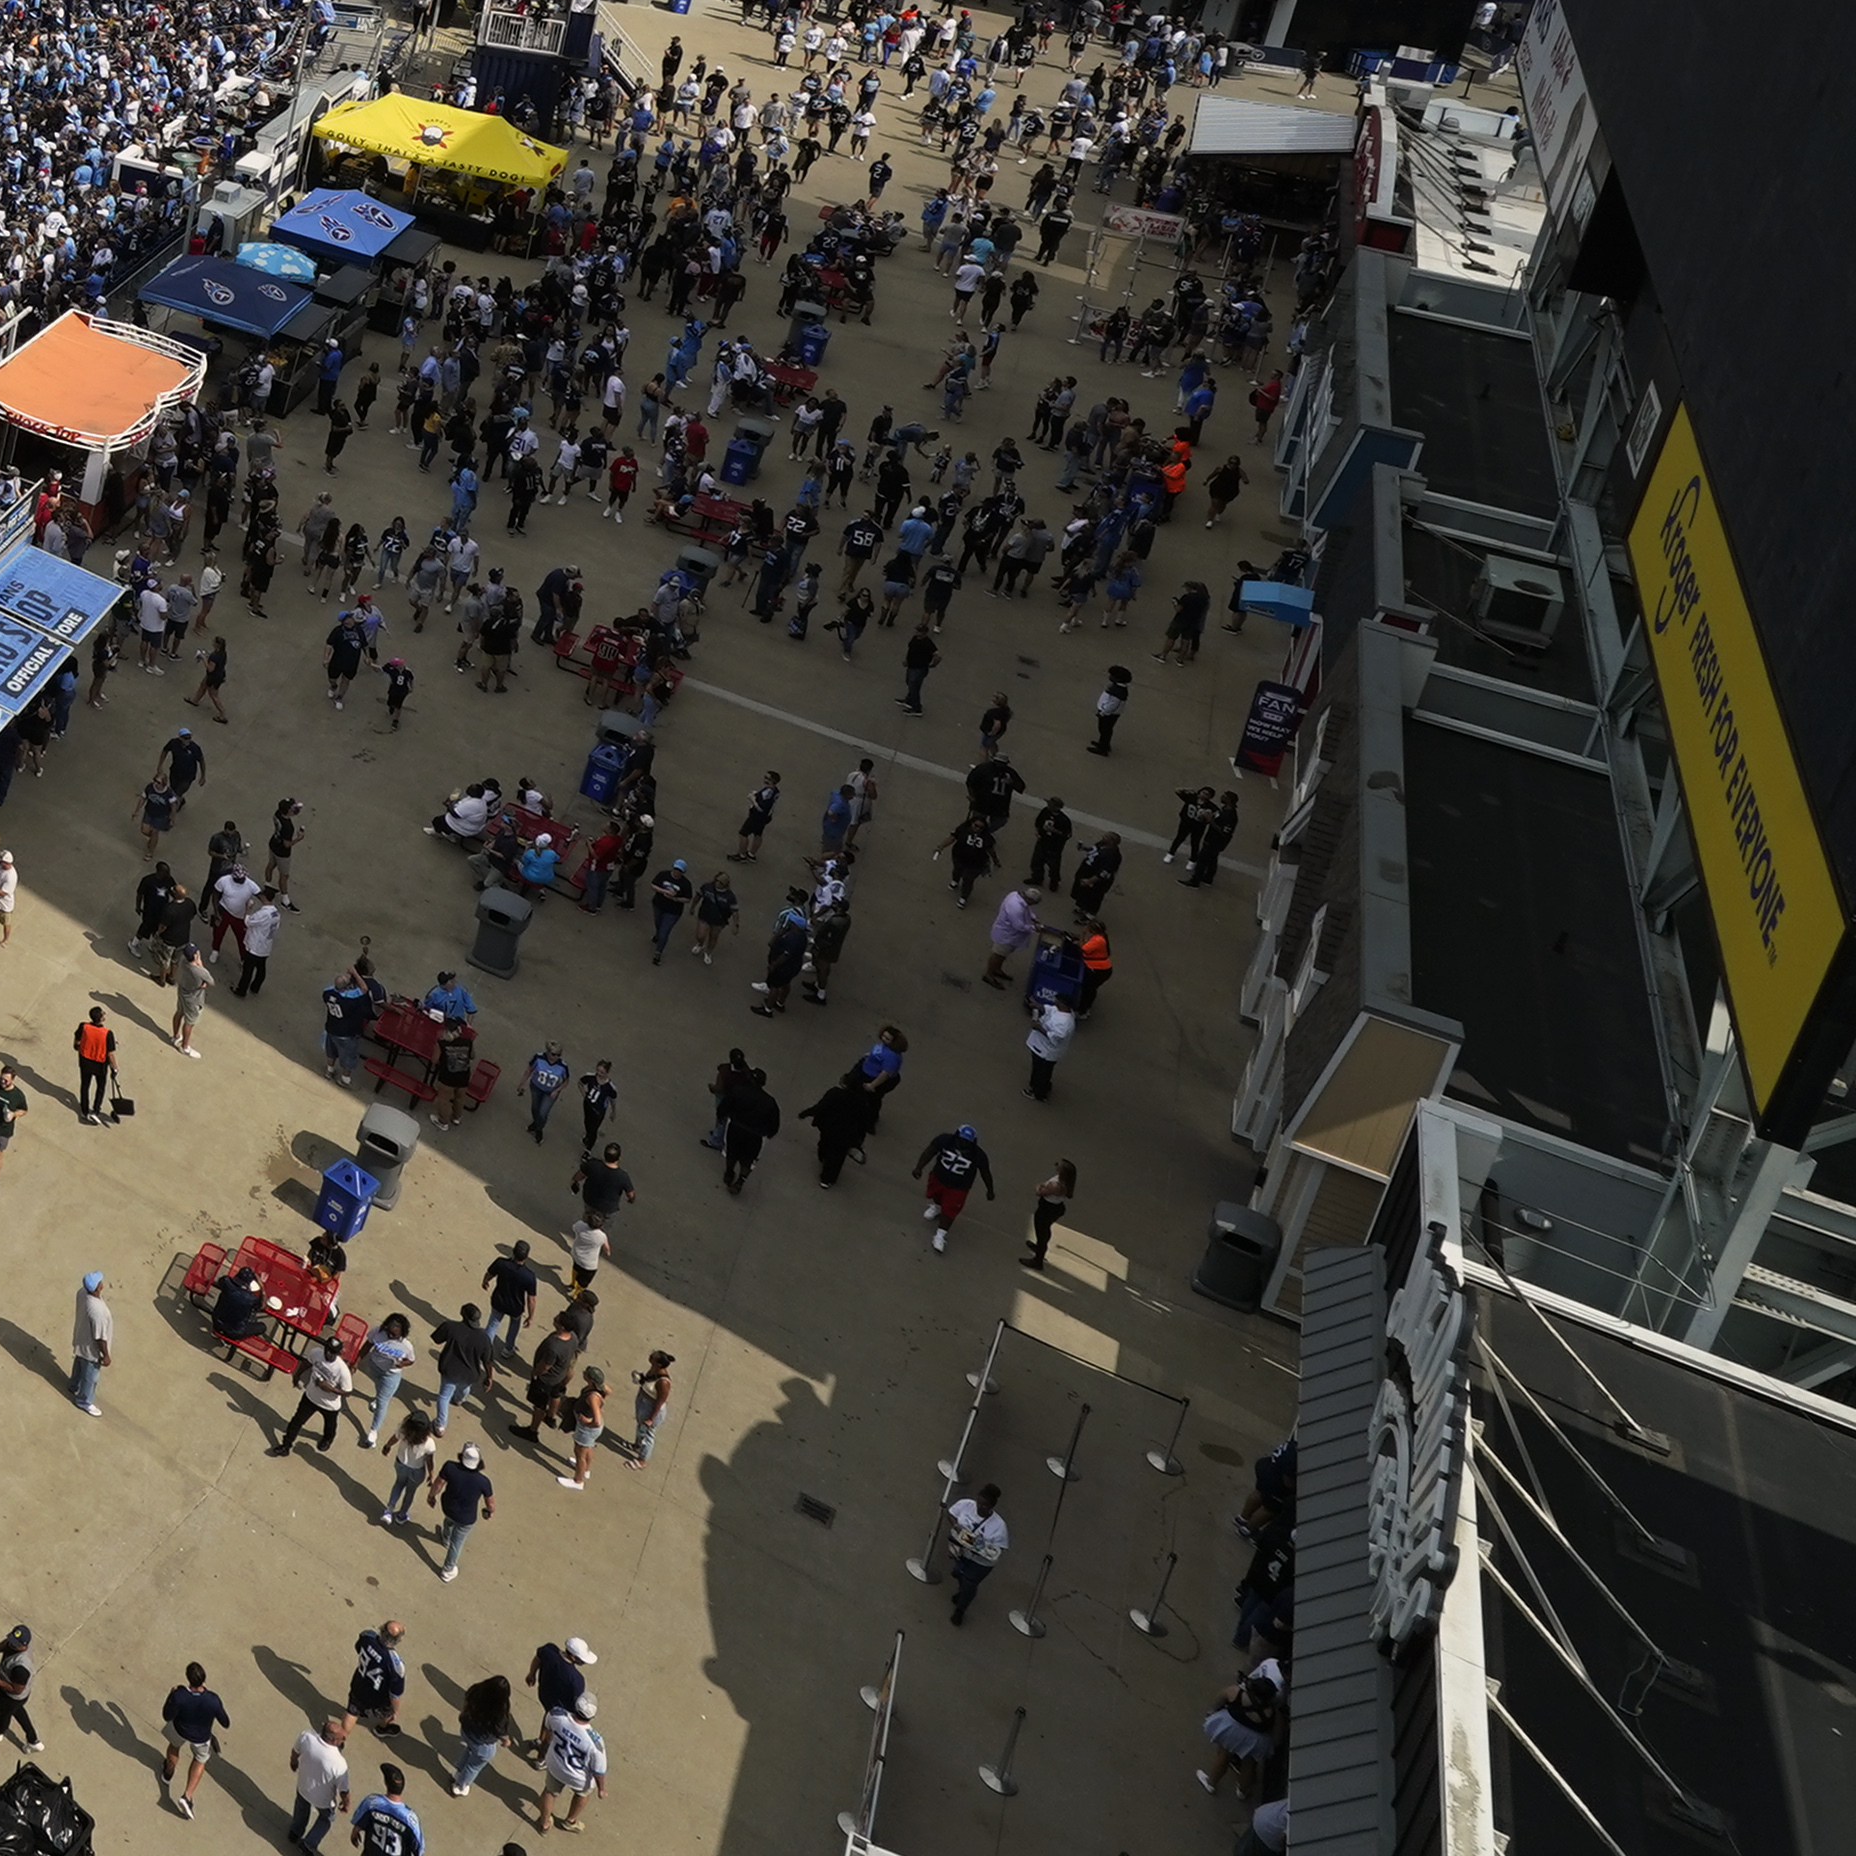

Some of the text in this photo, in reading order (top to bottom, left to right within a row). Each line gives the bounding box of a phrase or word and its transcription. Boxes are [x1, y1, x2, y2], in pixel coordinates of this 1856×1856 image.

[488, 168, 527, 184] DOG!
[513, 436, 528, 454] 31
[786, 514, 807, 535] 22
[851, 528, 876, 547] 58
[5, 644, 56, 694] OFFICIAL
[1259, 696, 1296, 715] FAN
[1655, 474, 1787, 951] Kroger FRESH FOR EVERYONE
